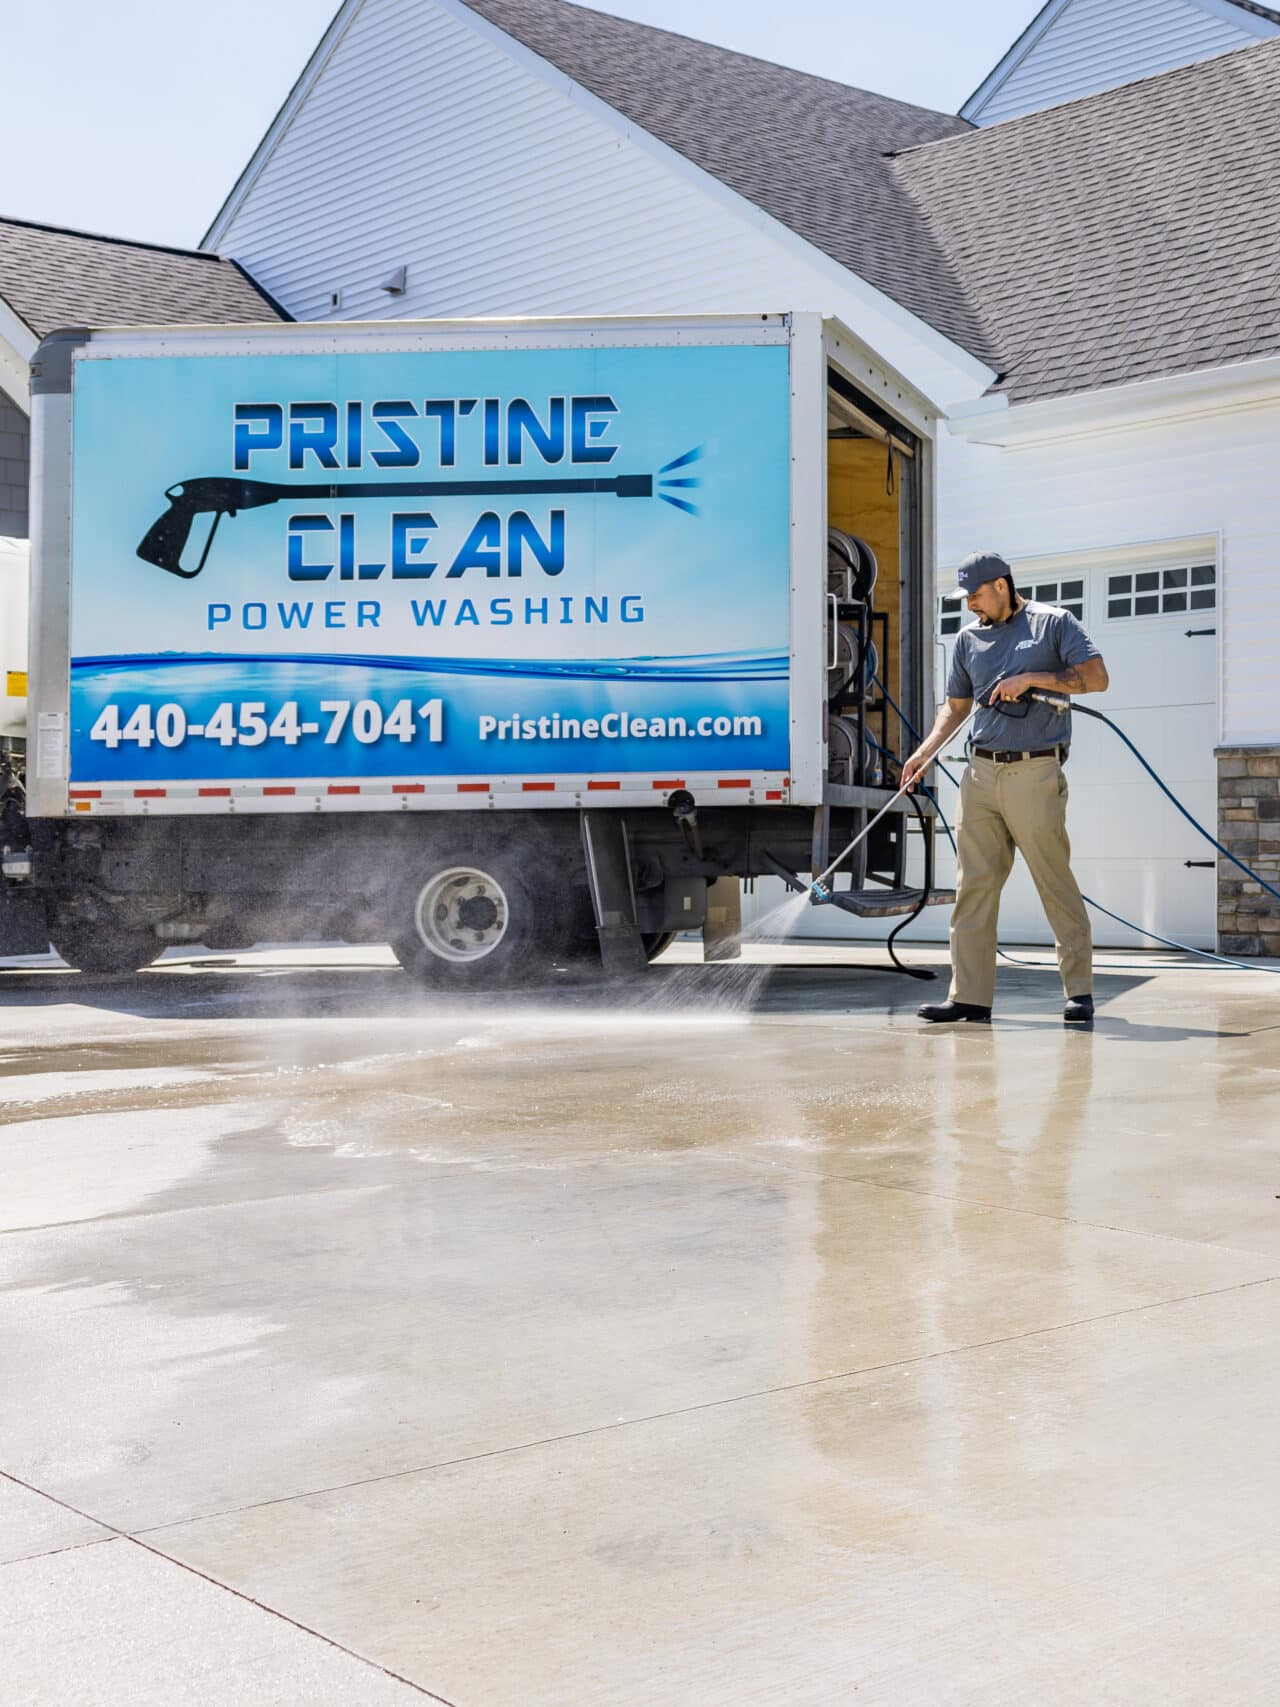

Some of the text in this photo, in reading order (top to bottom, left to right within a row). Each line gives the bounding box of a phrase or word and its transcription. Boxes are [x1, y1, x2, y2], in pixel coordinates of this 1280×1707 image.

[233, 395, 621, 471] PRISTINE
[287, 509, 566, 582] CLEAN
[207, 595, 645, 631] POWER WASHING
[90, 698, 443, 748] 440-454-7041
[479, 711, 762, 740] PristineClean.com
